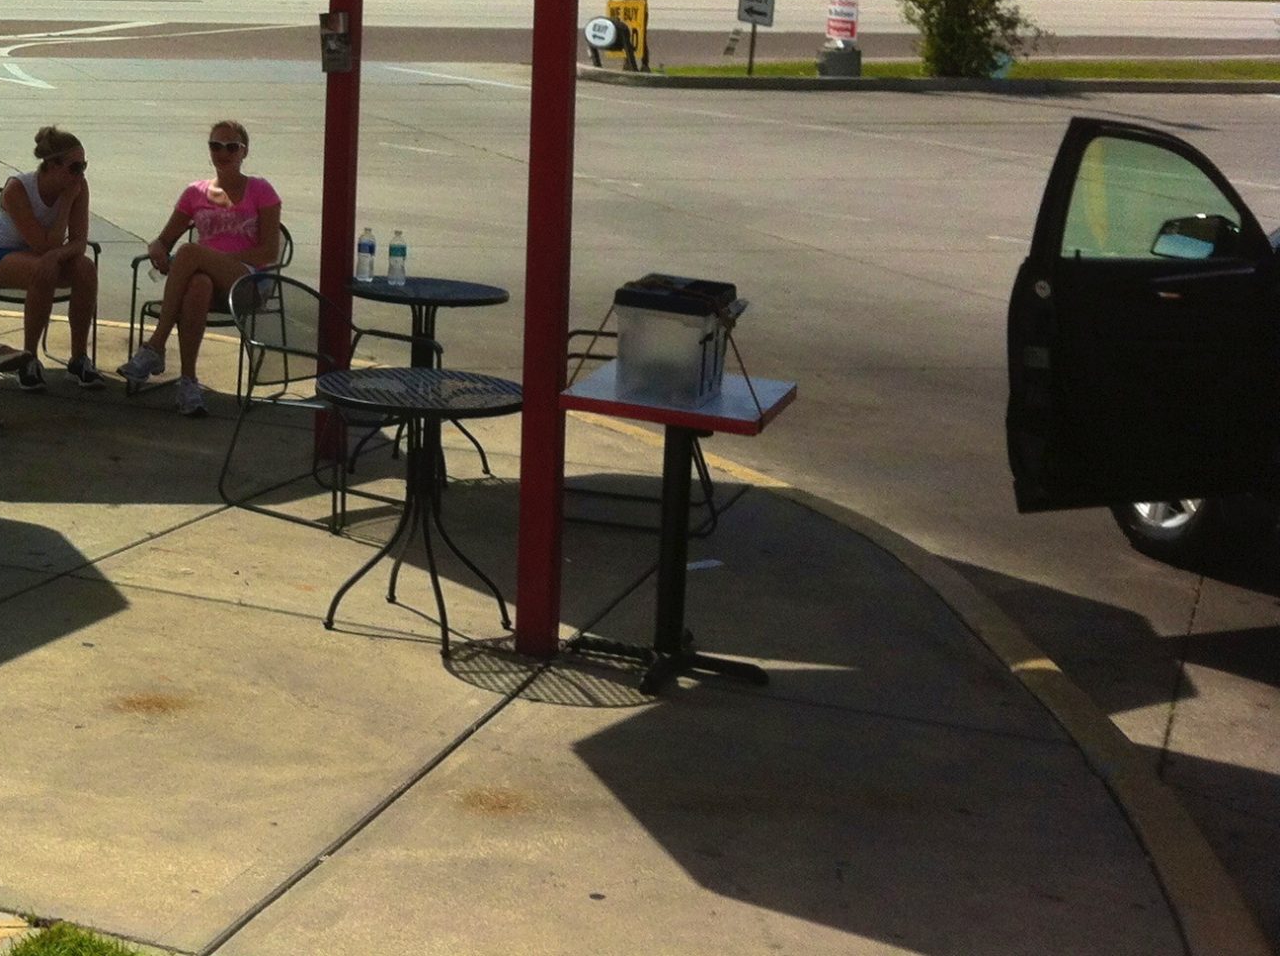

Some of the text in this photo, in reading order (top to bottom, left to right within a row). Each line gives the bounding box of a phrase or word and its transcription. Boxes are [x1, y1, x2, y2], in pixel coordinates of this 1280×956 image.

[609, 7, 639, 22] WE BUY
[592, 23, 609, 35] EXIT
